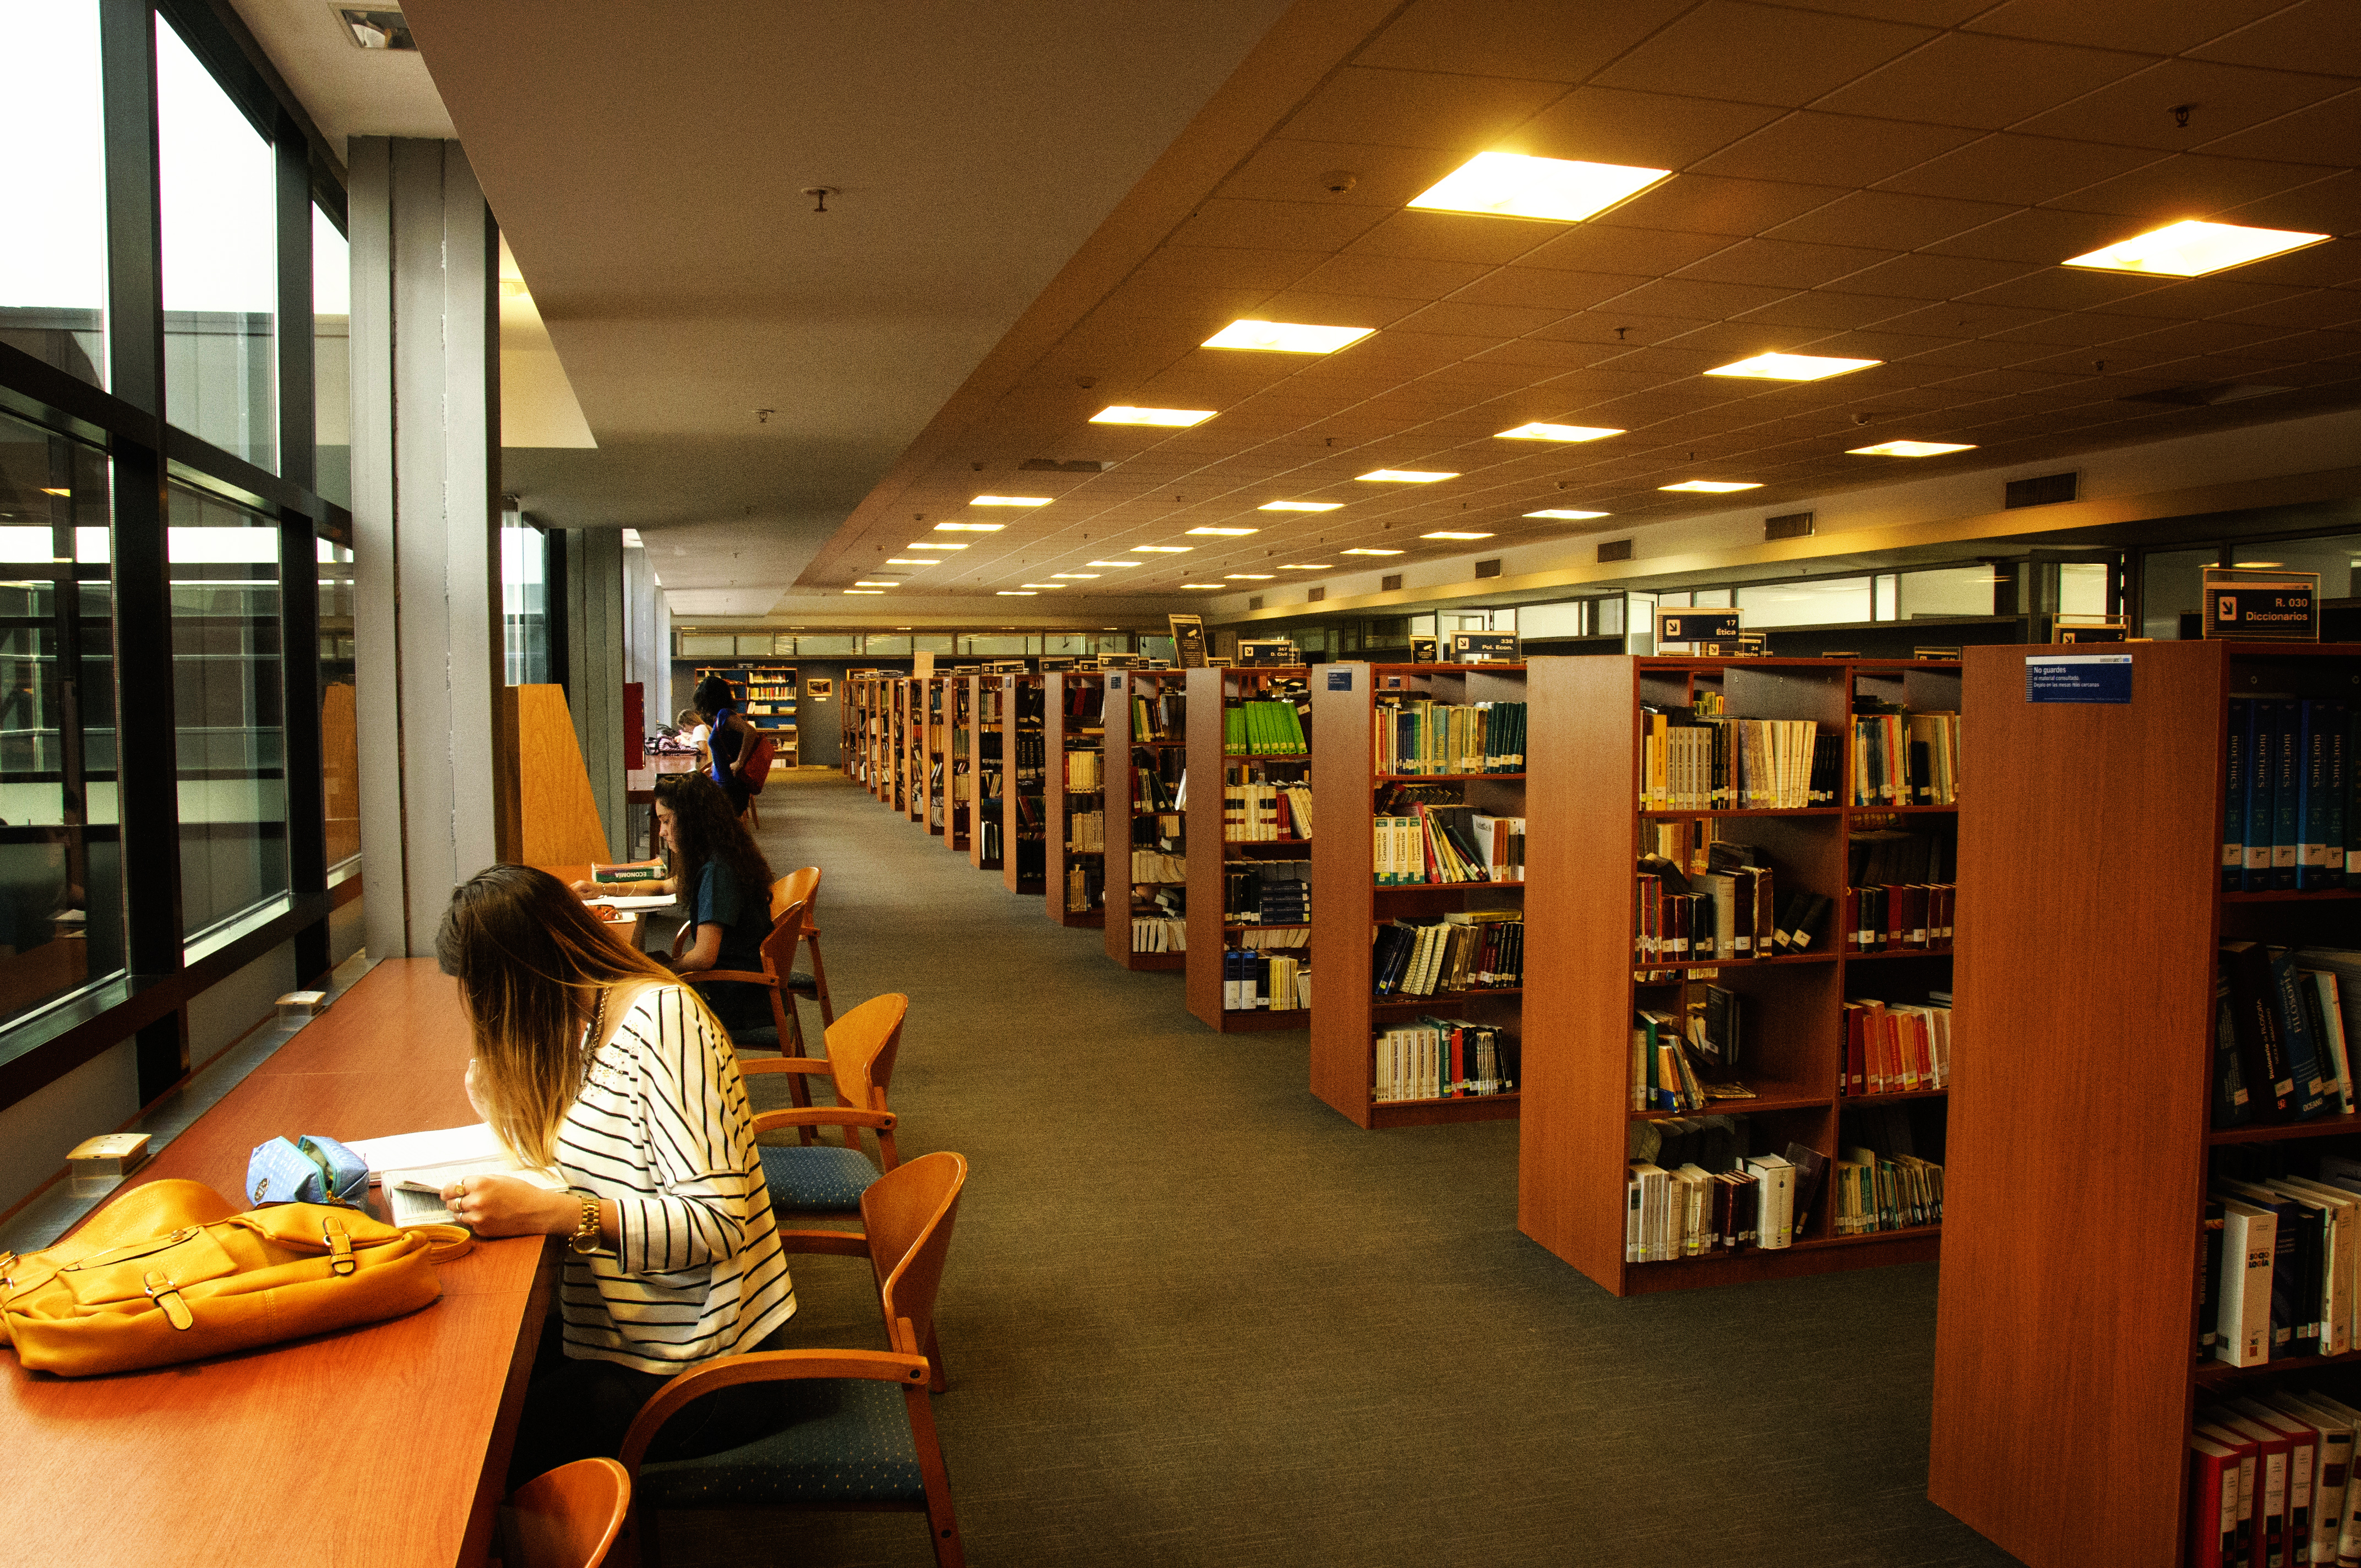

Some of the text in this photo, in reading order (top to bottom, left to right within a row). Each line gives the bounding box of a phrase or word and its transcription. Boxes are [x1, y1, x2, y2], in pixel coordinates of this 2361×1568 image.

[2246, 612, 2308, 621] Diccionarios
[2276, 598, 2308, 607] R. 030
[2230, 735, 2238, 790] BIOETHICS
[2257, 734, 2266, 788] BIOETHICS
[2313, 734, 2321, 787] BIOETHICS
[2256, 998, 2267, 1035] FILOSOFÍA
[2283, 968, 2302, 1033] FILOSOFÍA
[2264, 1044, 2275, 1079] Diccionario
[2249, 1251, 2269, 1260] SOCIO
[2249, 1259, 2269, 1268] LOGÍA
